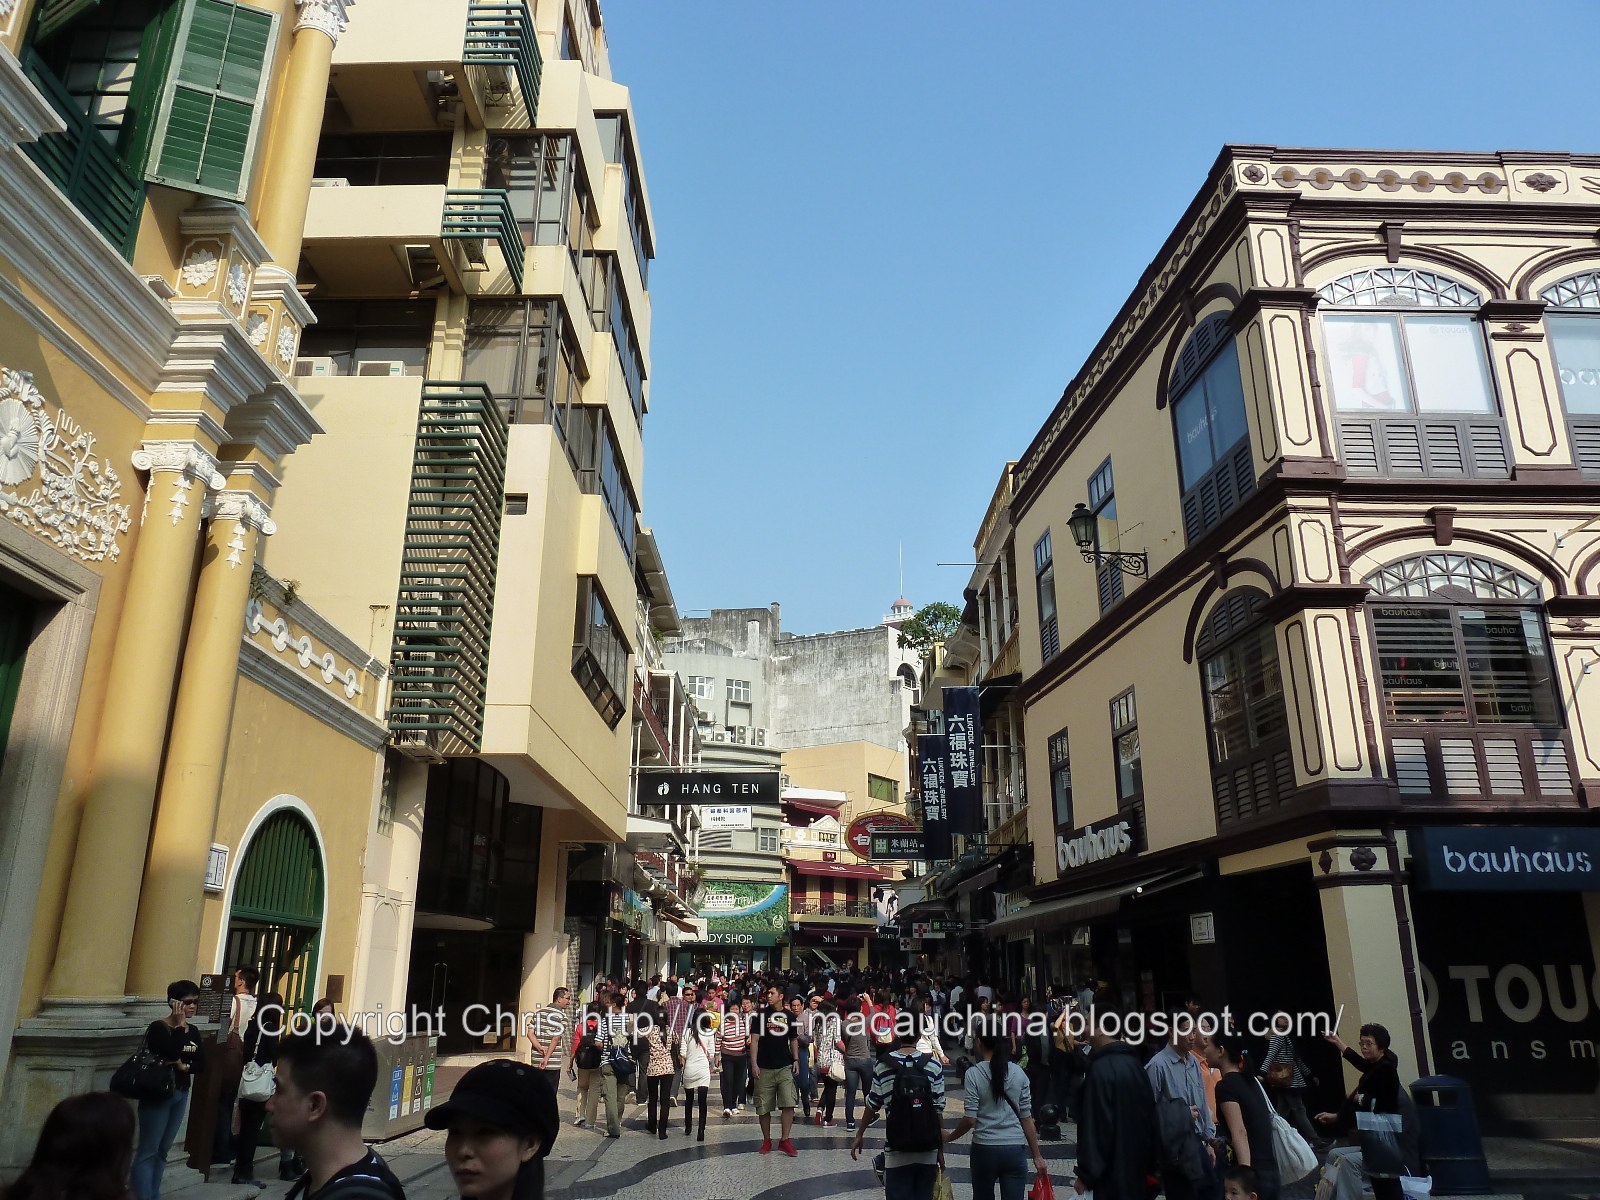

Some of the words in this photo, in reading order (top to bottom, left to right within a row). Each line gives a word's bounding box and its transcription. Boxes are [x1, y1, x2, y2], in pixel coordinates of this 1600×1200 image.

[1558, 362, 1600, 386] ba
[1381, 608, 1422, 617] bauhaus
[1485, 625, 1517, 634] bauha
[948, 714, 969, 788] 六福珠寶
[681, 784, 721, 794] HANG
[732, 784, 760, 794] TEN
[922, 757, 940, 821] 六福珠寶
[1057, 821, 1132, 871] bauhaus
[1442, 845, 1593, 873] bauhaus
[1448, 963, 1600, 1023] TOU
